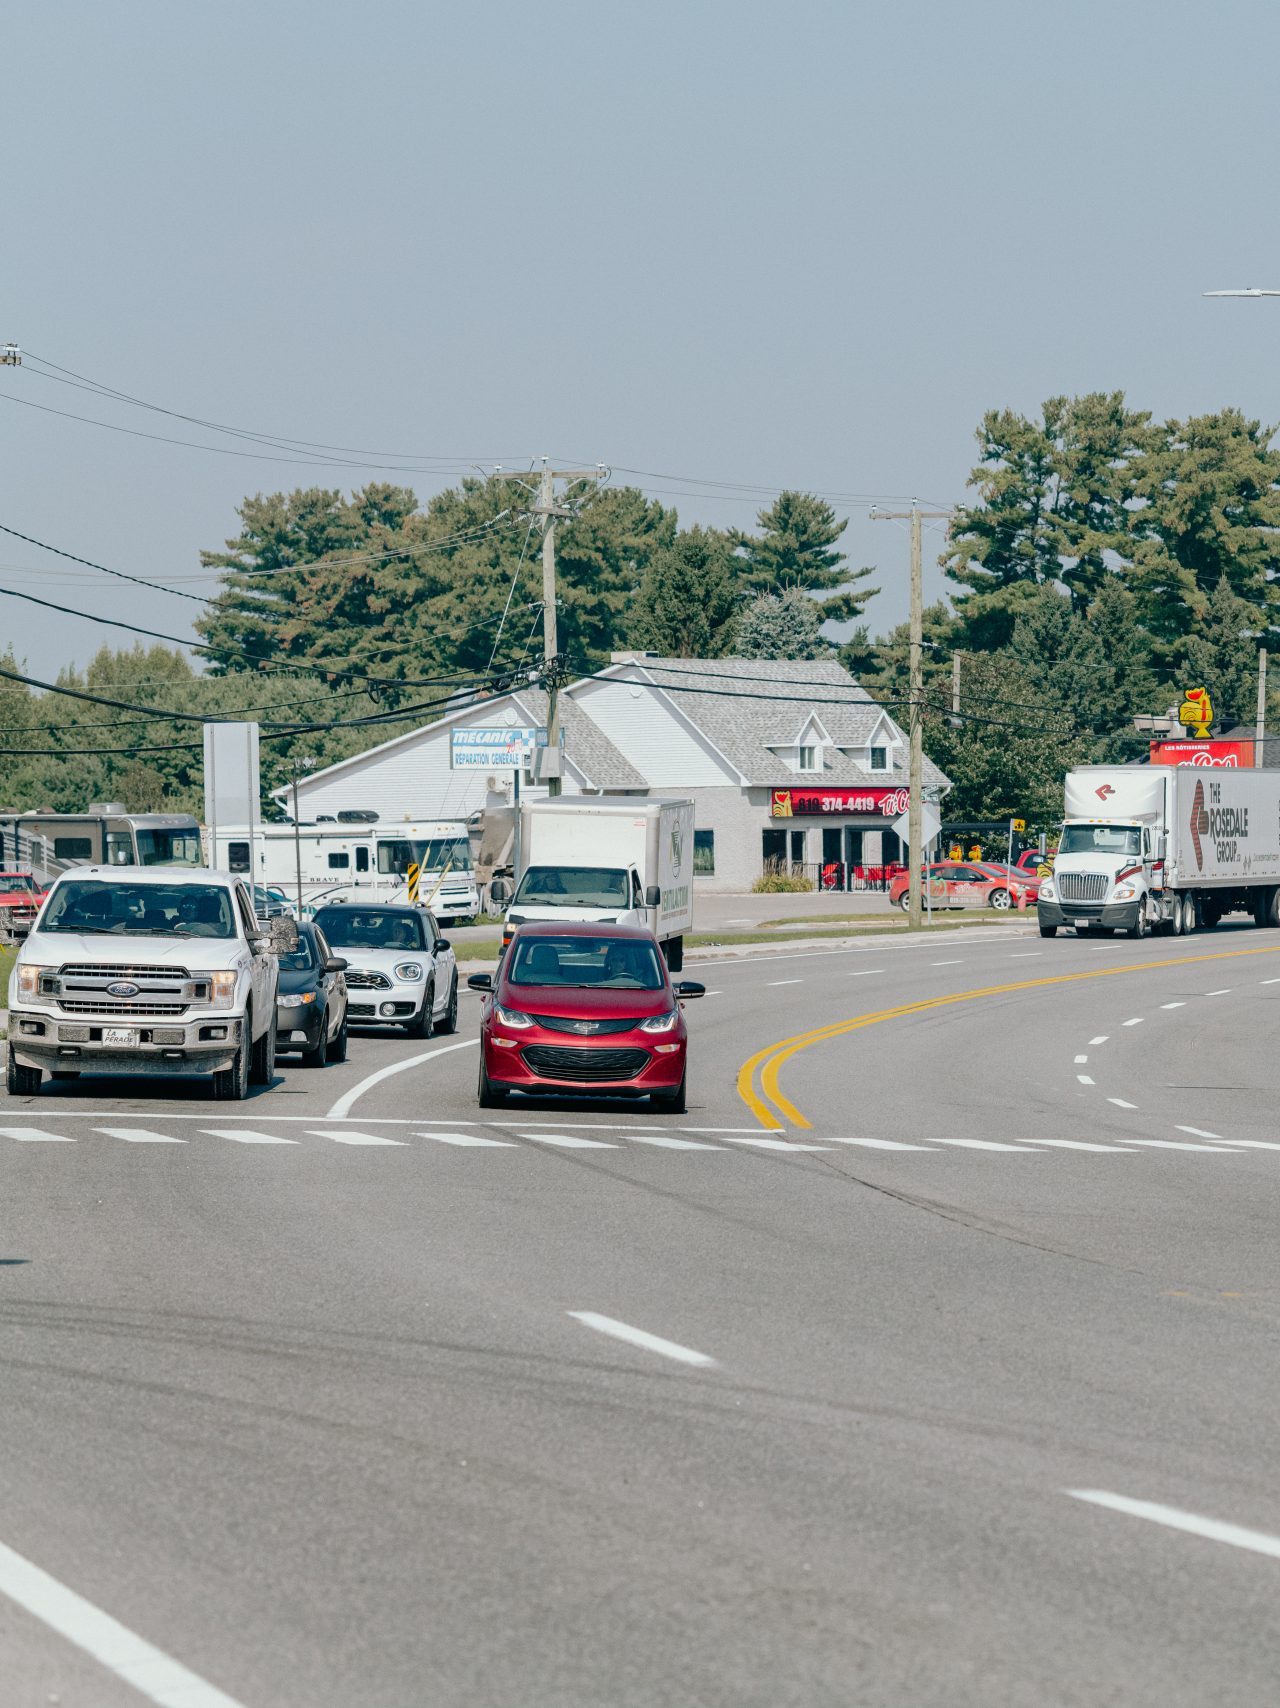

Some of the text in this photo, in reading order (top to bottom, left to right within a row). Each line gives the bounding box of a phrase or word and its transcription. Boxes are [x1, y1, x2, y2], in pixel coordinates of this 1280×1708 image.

[1209, 782, 1221, 804] THE
[821, 796, 875, 812] 374-4419
[1209, 807, 1249, 844] ROSEDALE
[114, 985, 131, 994] Ford
